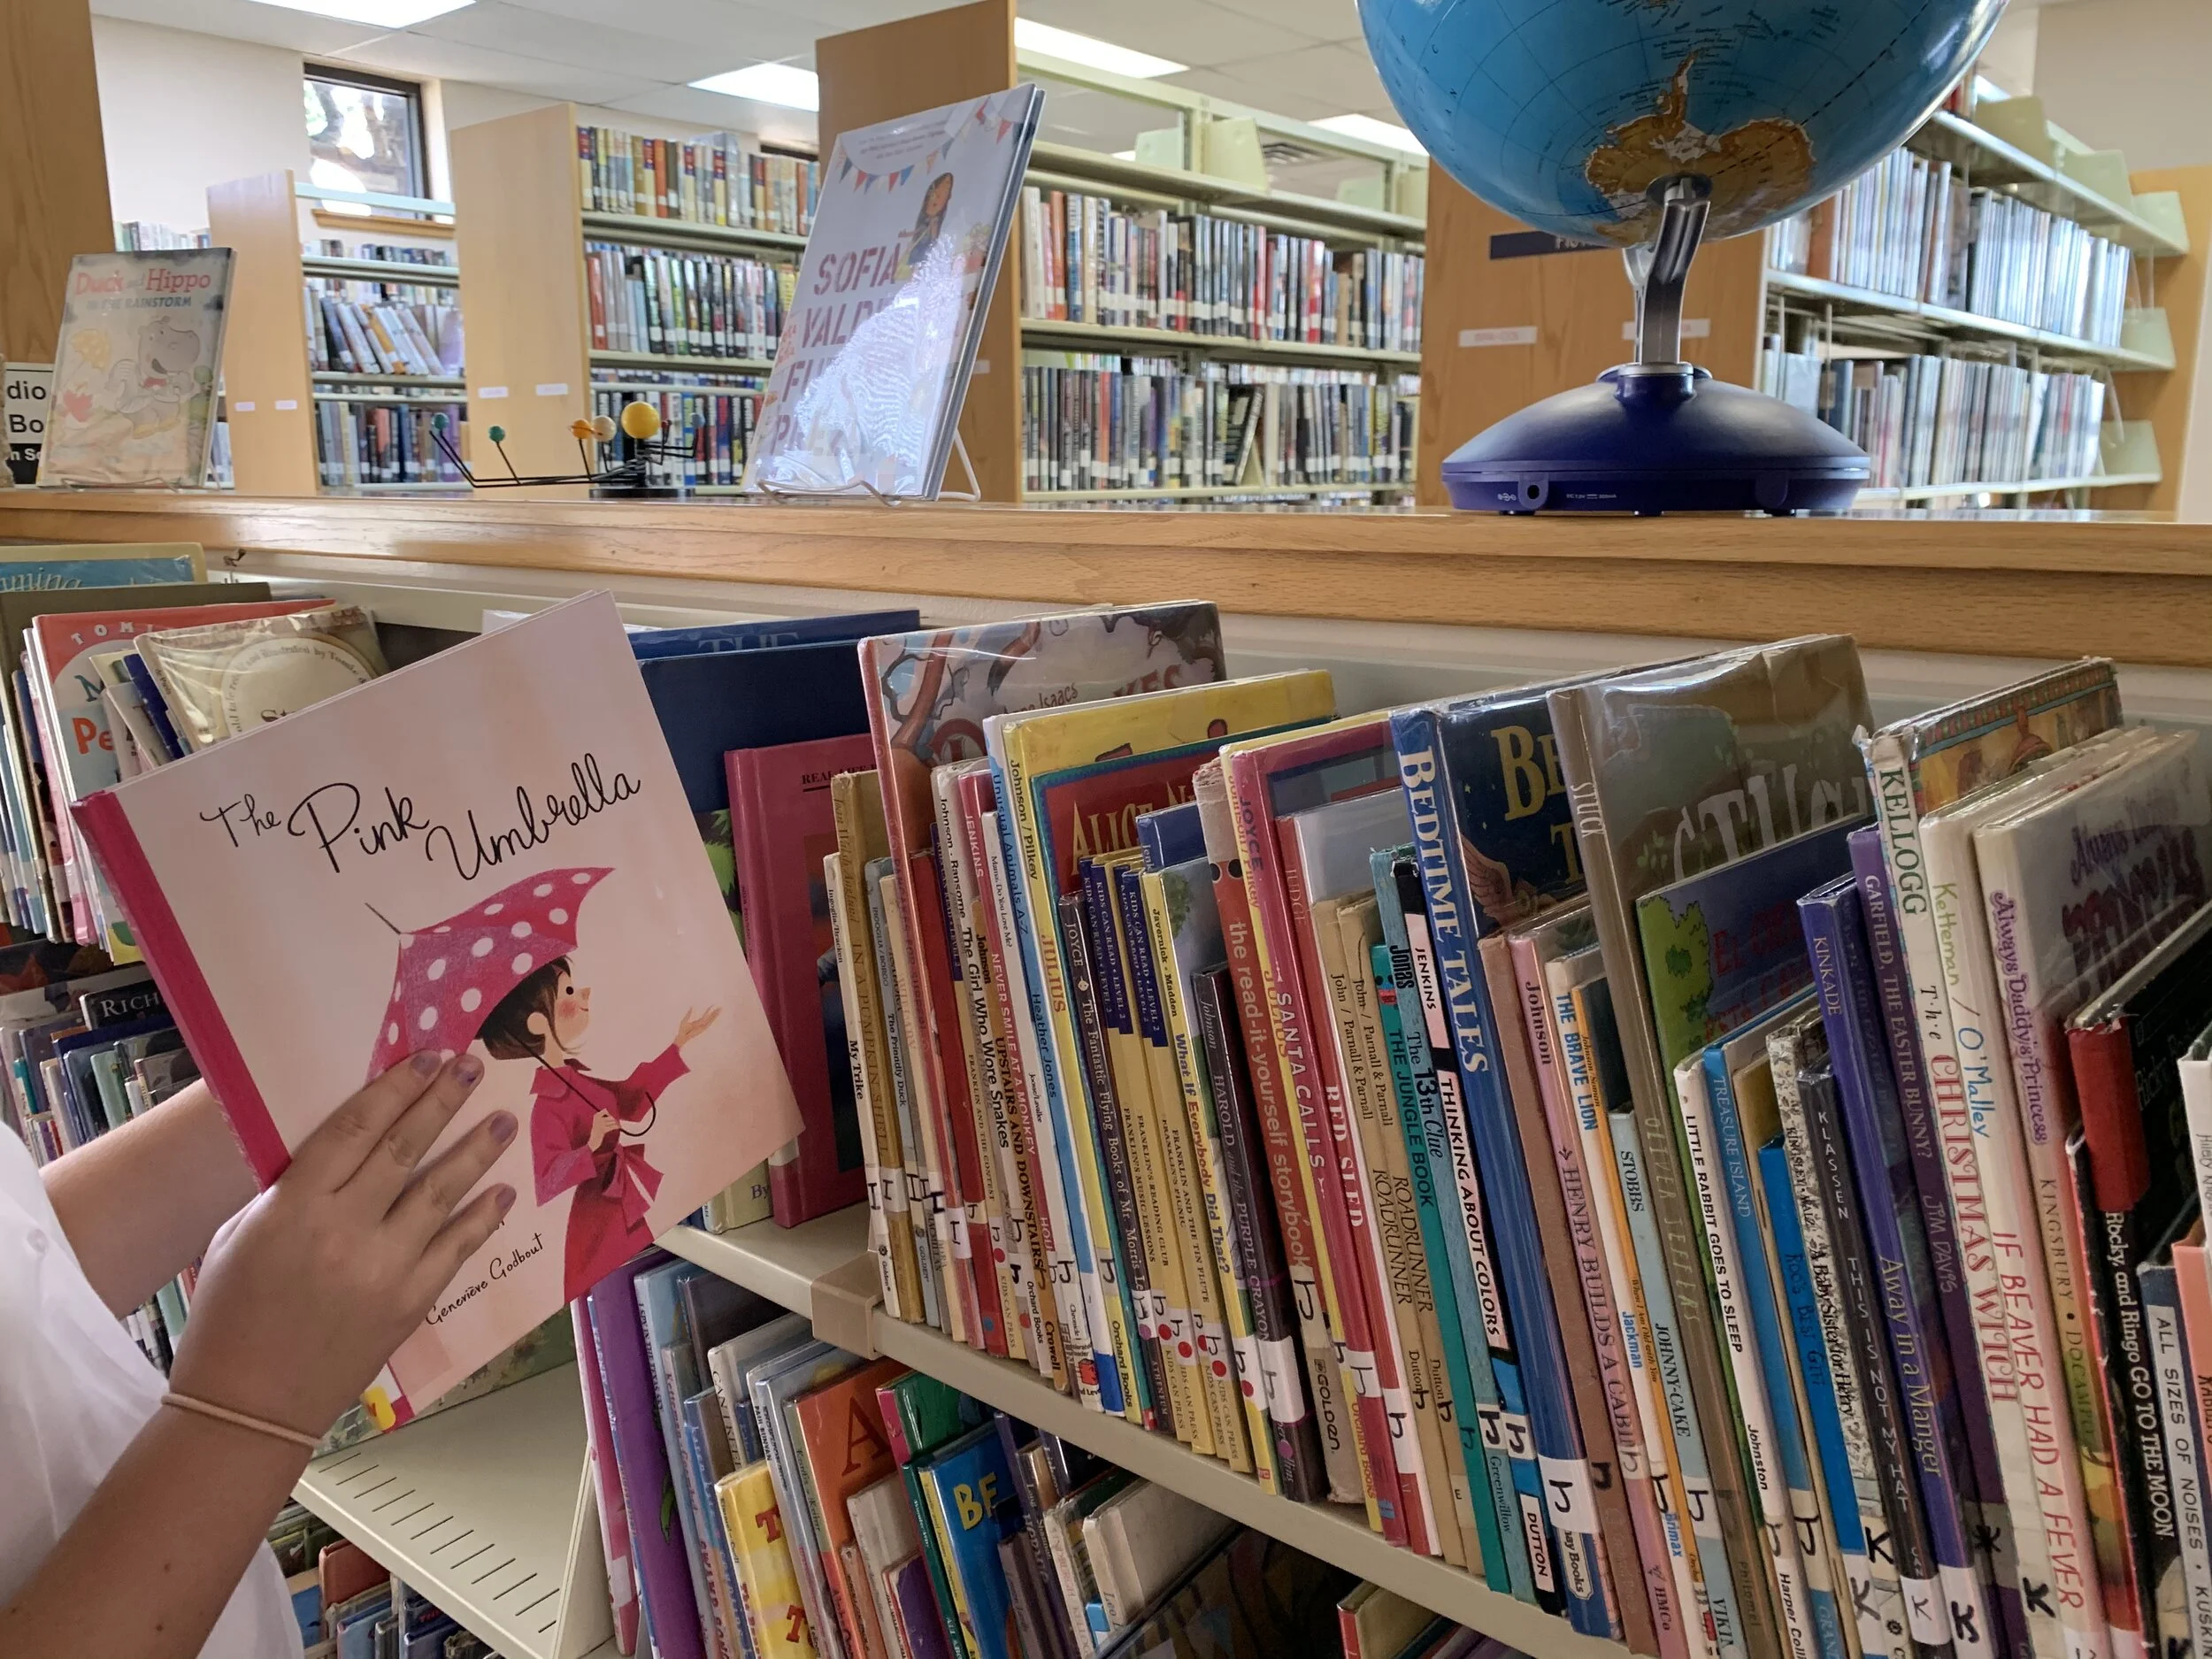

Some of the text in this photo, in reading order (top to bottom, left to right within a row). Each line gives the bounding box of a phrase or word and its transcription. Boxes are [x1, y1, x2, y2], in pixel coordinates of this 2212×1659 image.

[146, 268, 212, 293] Hippo
[813, 242, 899, 296] SOFIA
[7, 380, 47, 400] dio
[10, 414, 44, 434] Bo
[200, 752, 641, 881] The Pink Umbrella
[940, 797, 954, 853] Johnson
[1570, 781, 1606, 839] STUCK
[950, 860, 966, 918] Ransome
[962, 926, 974, 958] The
[993, 774, 1057, 1098] Unusual Animals A-Z Heather Jones
[1010, 759, 1066, 1013] Johnson Pilkey JULIUS
[1396, 744, 1490, 1073] BEDTIME TALES
[1864, 874, 1894, 971] GARFIELD,
[851, 943, 864, 965] IN
[965, 815, 1036, 1156] JENKINS MONKEY
[968, 964, 980, 994] Girl
[1238, 795, 1325, 1168] JOYCE SANTA CALLS
[1883, 973, 1902, 1012] THE
[849, 1039, 864, 1100] My Trike
[974, 997, 987, 1036] Who
[980, 1040, 997, 1086] Wore
[1228, 920, 1289, 1148] the read-it-yourself
[1389, 944, 1439, 1115] Jonas The 13th
[1891, 1016, 1916, 1083] EASTER
[1990, 891, 2048, 1146] Always Daddy's Princess
[895, 1079, 907, 1107] Duck
[990, 1089, 1010, 1148] Snakes
[1064, 922, 1141, 1273] JOYCE The Flying Books Mr. Morris
[1164, 973, 1231, 1274] Madden What If Everybody Did That?
[1330, 974, 1413, 1305] John Parnall Parnall ROADRUNNER
[1388, 1028, 1435, 1208] THE JUNGLE BOOK
[1415, 948, 1501, 1336] JENKINS THINKING ABOUT COLORS
[1878, 766, 2019, 1404] KELLOGG CHRISTMAS WITCH
[1904, 1087, 1934, 1160] BUNNY?
[1212, 1074, 1270, 1340] HAROLD PURPLE CRAYON
[1363, 1025, 1433, 1313] Parnall Parnall ROADRUNNER
[1525, 980, 1617, 1371] Johnson HENRY BUILDS A
[1555, 992, 1643, 1369] THE BRAVE LION Jackman
[1713, 1076, 1752, 1218] TREASURE ISLAND
[1812, 936, 1941, 1479] KINKADE Away in Manger
[489, 1232, 545, 1280] Godbout
[1018, 1159, 1045, 1271] DOWNSTAIRS
[1686, 1115, 1743, 1354] LITTLE RABBIT GOES TO SLEEP
[1932, 881, 2085, 1609] Ketteman BEAVER HAD A FEVER
[2039, 1179, 2074, 1300] KINGSBURY
[1033, 1315, 1044, 1344] Books
[1620, 1150, 1692, 1439] STOBBS JOHNNY-CAKE
[1817, 1110, 1897, 1455] KLASSEN THIS NOT MY
[1044, 1320, 1062, 1371] Crowell
[1111, 1320, 1133, 1408] Orchard Books
[1830, 1345, 1846, 1371] for
[2115, 1271, 2176, 1539] and Ringo GO TO MOON
[1489, 1455, 1513, 1533] Greenwillow
[2156, 1317, 2203, 1550] ALL SIZES OF NOISES
[1525, 1511, 1548, 1578] DUTTON
[1567, 1552, 1585, 1594] Books
[1746, 1424, 1798, 1624] Johnston Harper
